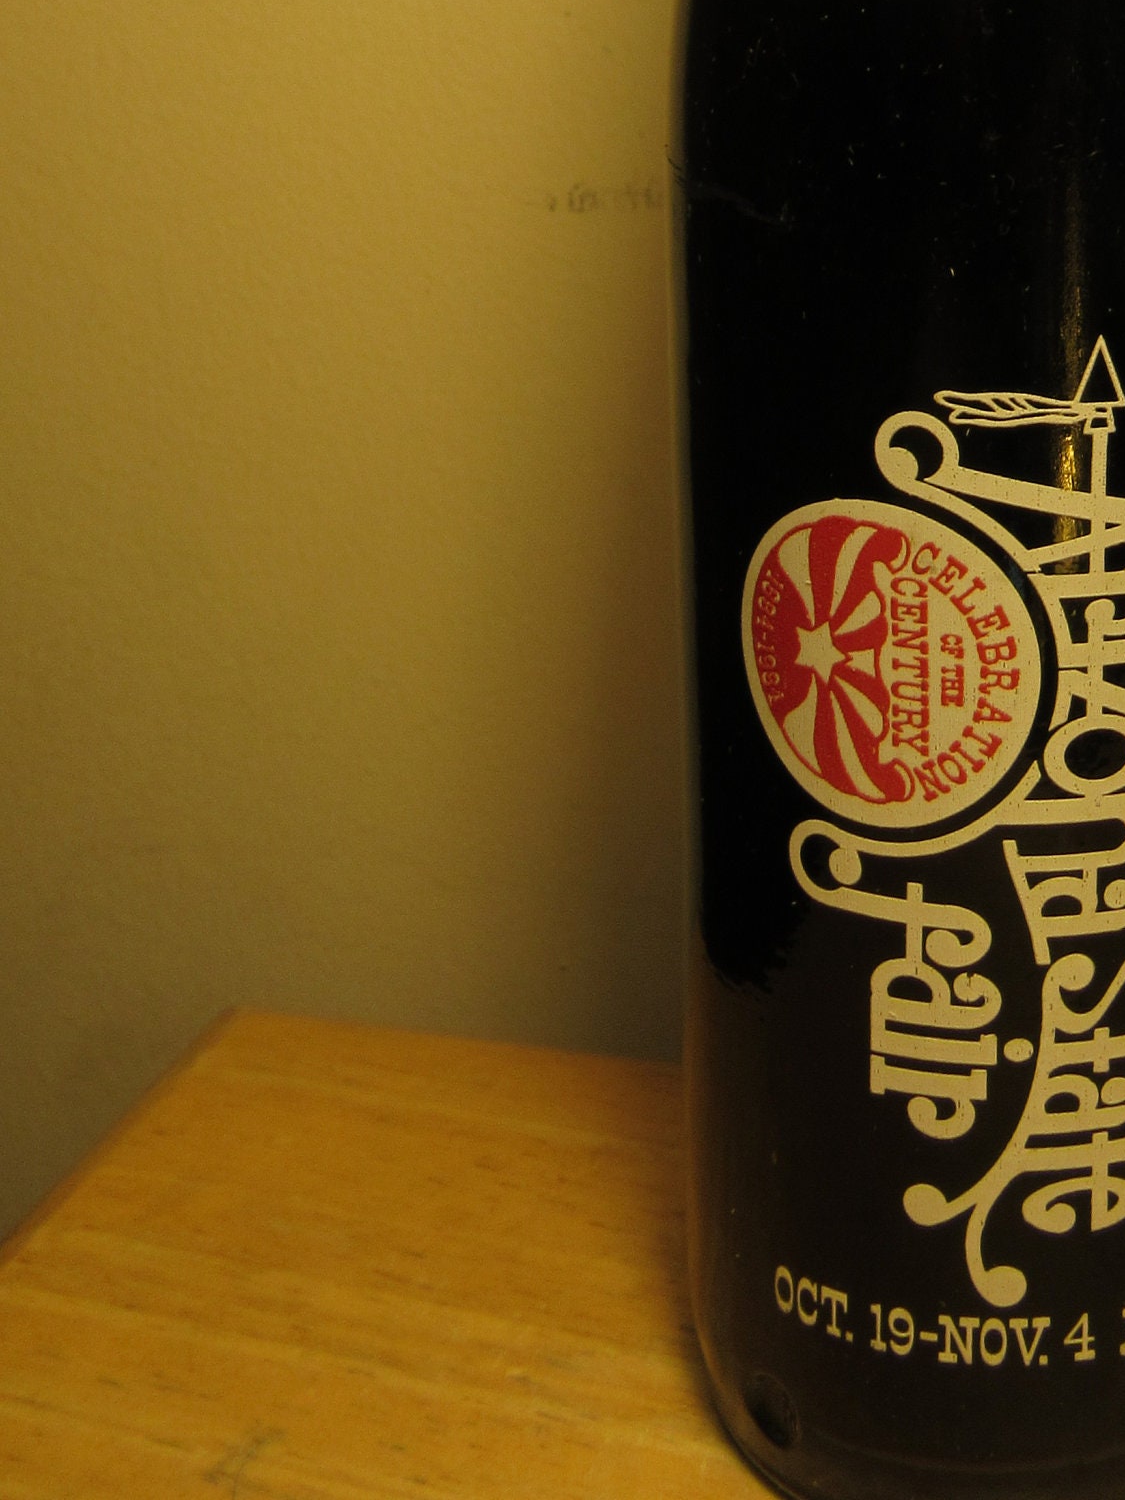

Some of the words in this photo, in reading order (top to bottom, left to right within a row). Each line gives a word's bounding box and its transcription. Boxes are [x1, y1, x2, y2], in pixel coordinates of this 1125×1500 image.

[890, 575, 930, 757] CENTURY
[911, 541, 1021, 802] CELEBRATION
[940, 665, 965, 708] THE
[774, 1265, 854, 1343] OCT.
[869, 1303, 1051, 1367] 19-NOV.
[1063, 1312, 1097, 1363] 4
